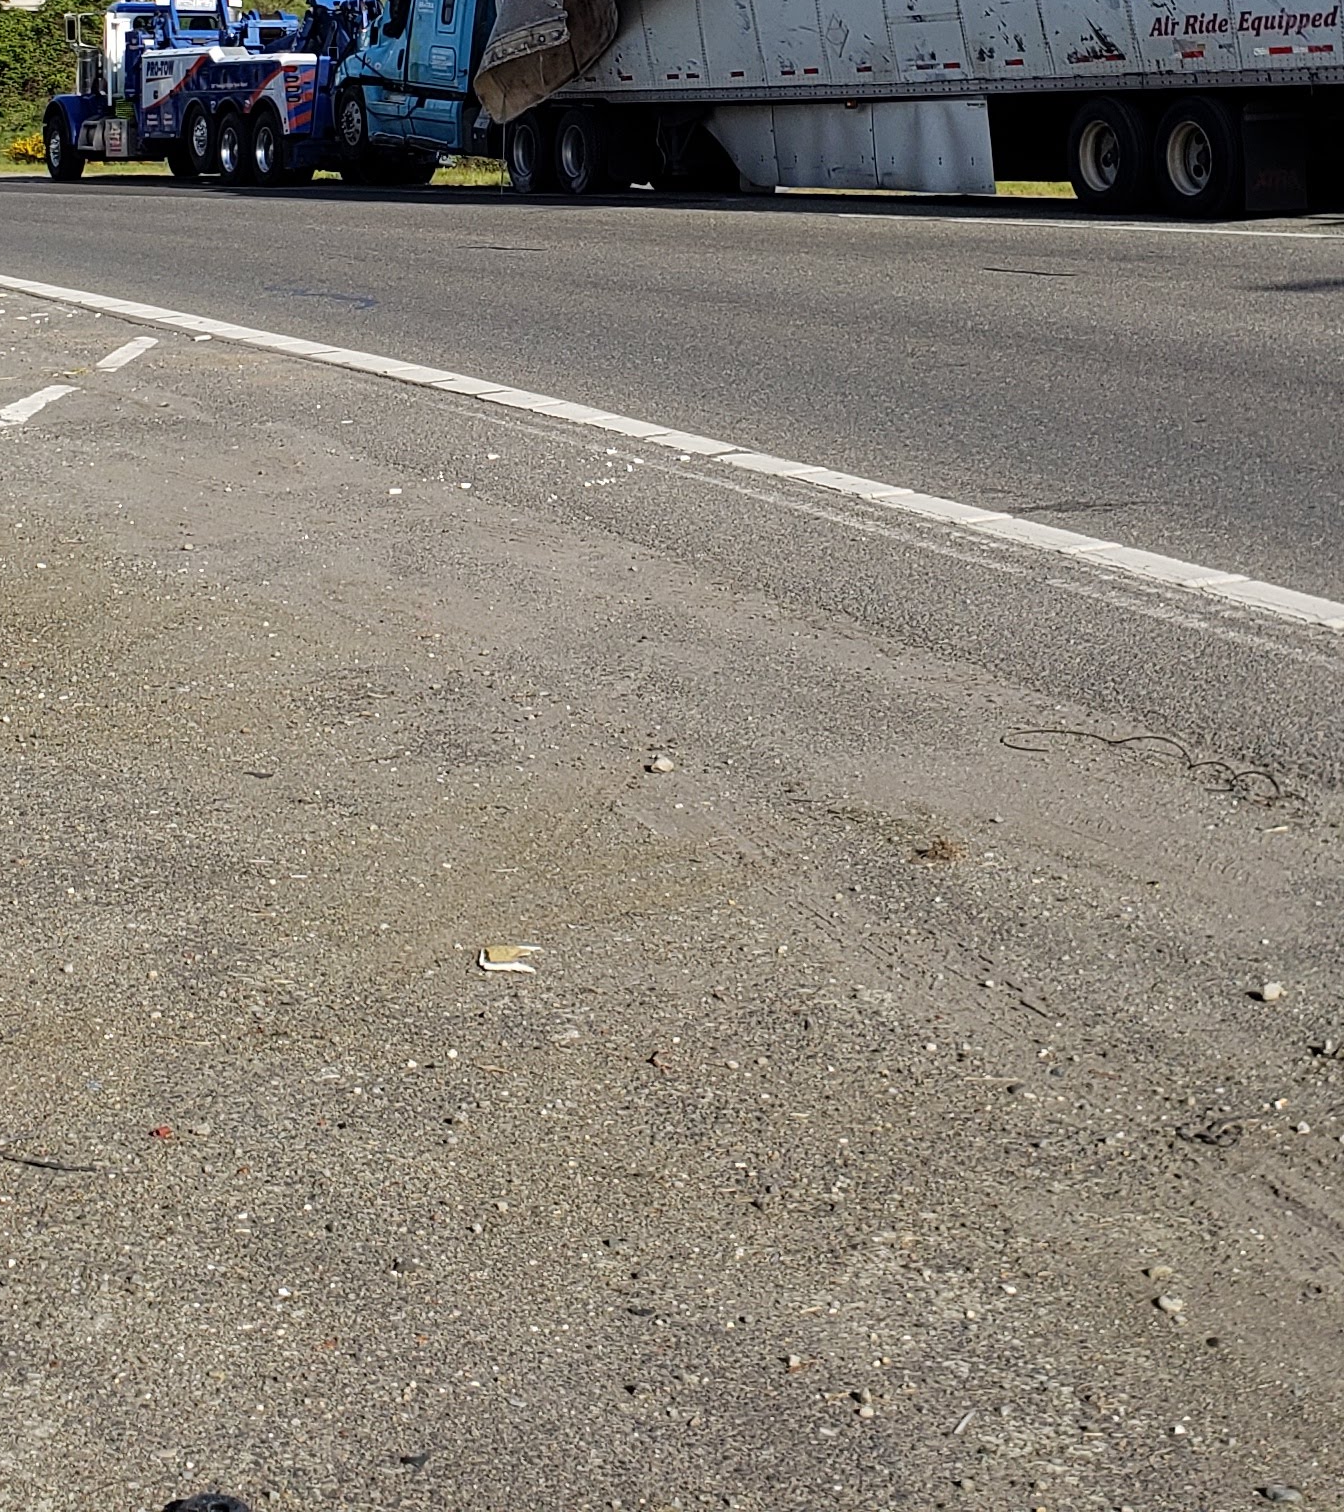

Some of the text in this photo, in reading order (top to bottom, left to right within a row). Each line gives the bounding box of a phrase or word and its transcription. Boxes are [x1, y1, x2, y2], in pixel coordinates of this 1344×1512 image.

[1149, 5, 1339, 37] Air Ride Equipped
[146, 60, 175, 77] PRO-TOW
